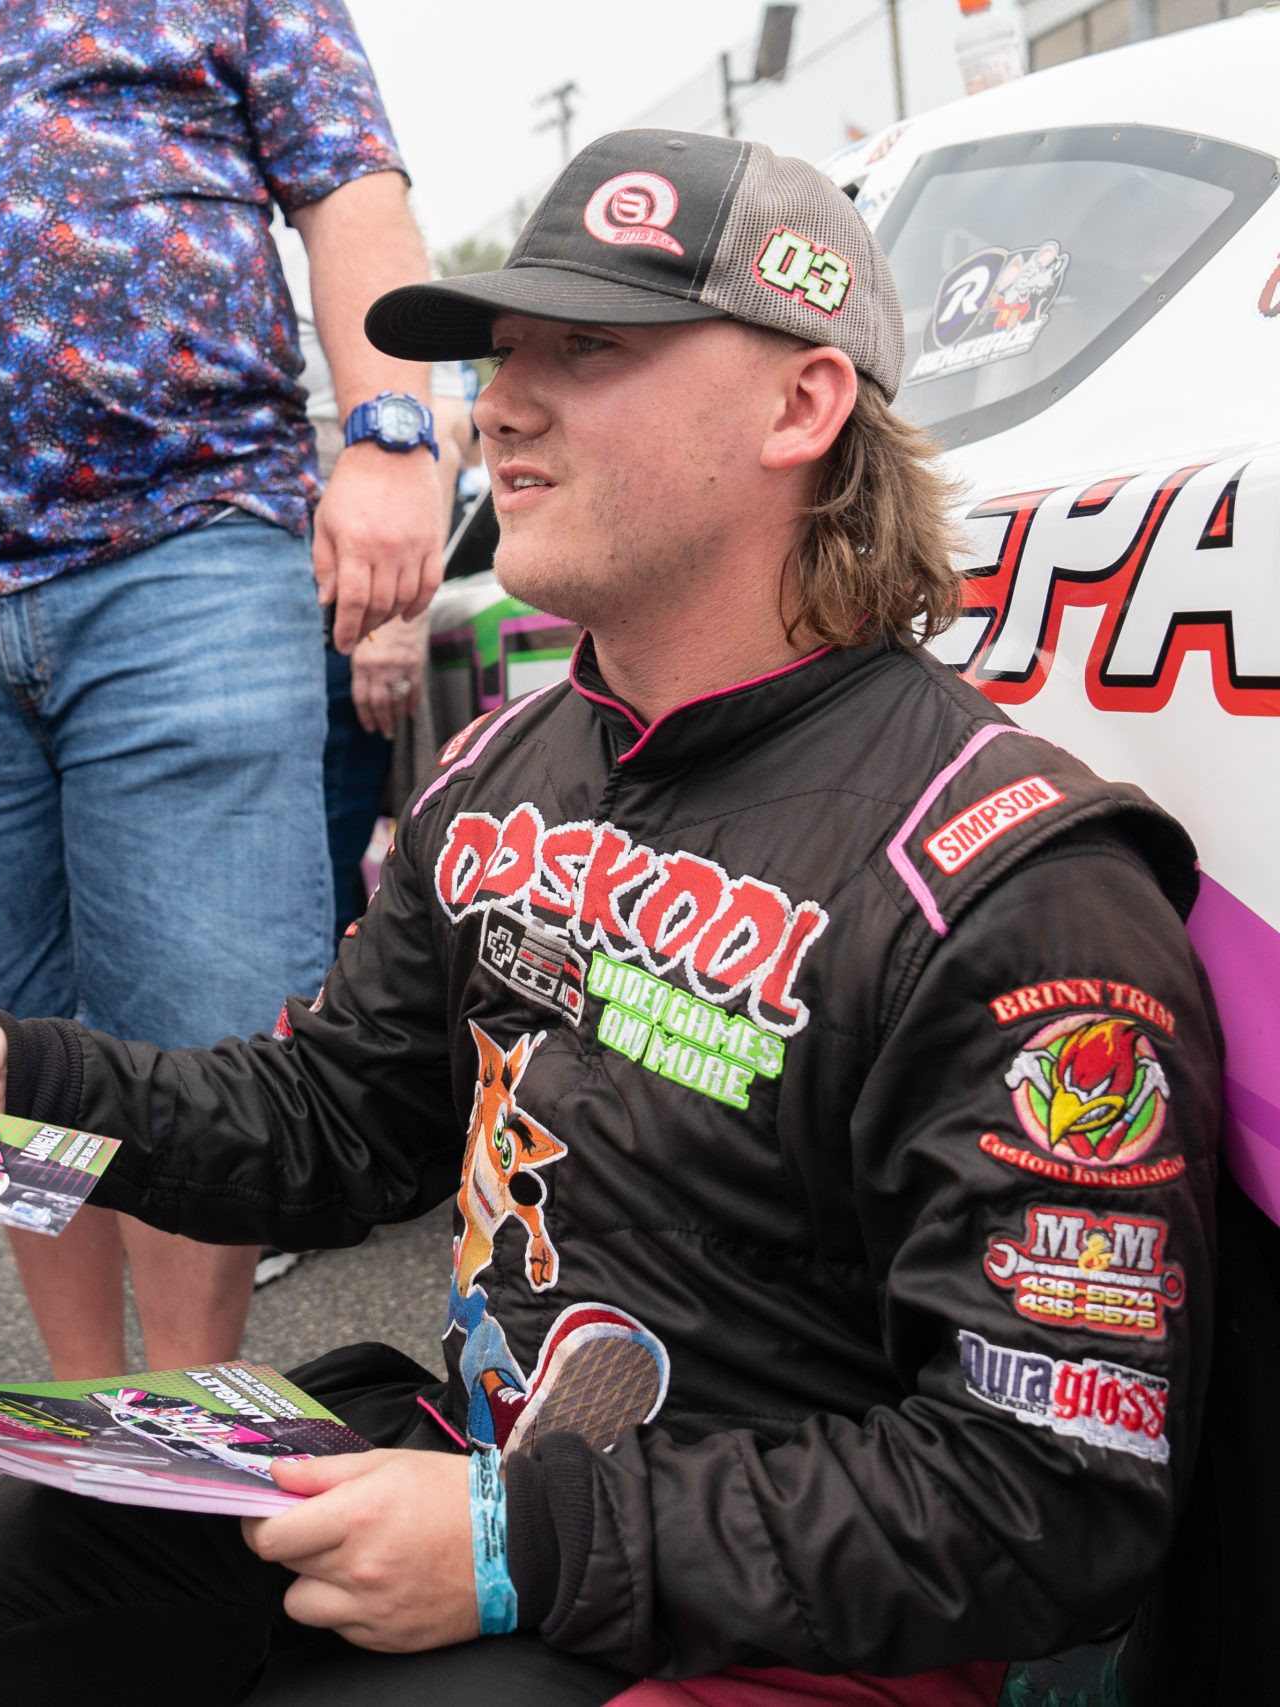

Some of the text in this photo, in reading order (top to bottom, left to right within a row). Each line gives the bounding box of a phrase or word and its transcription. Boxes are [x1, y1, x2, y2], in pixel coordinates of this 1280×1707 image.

[756, 229, 851, 316] 03
[937, 264, 991, 325] R
[910, 320, 1044, 378] RENEGADE
[937, 782, 1051, 862] SIMPSON
[592, 957, 782, 1074] VIDEO GAMES
[991, 980, 1175, 1036] BRINN TRIM
[600, 1007, 752, 1104] AND MORE
[979, 1133, 1069, 1180] Custom
[1030, 1212, 1160, 1272] M&M
[1019, 1293, 1157, 1329] 438-5575
[1020, 1275, 1156, 1309] 438-5574
[184, 1371, 277, 1424] LANGLEY
